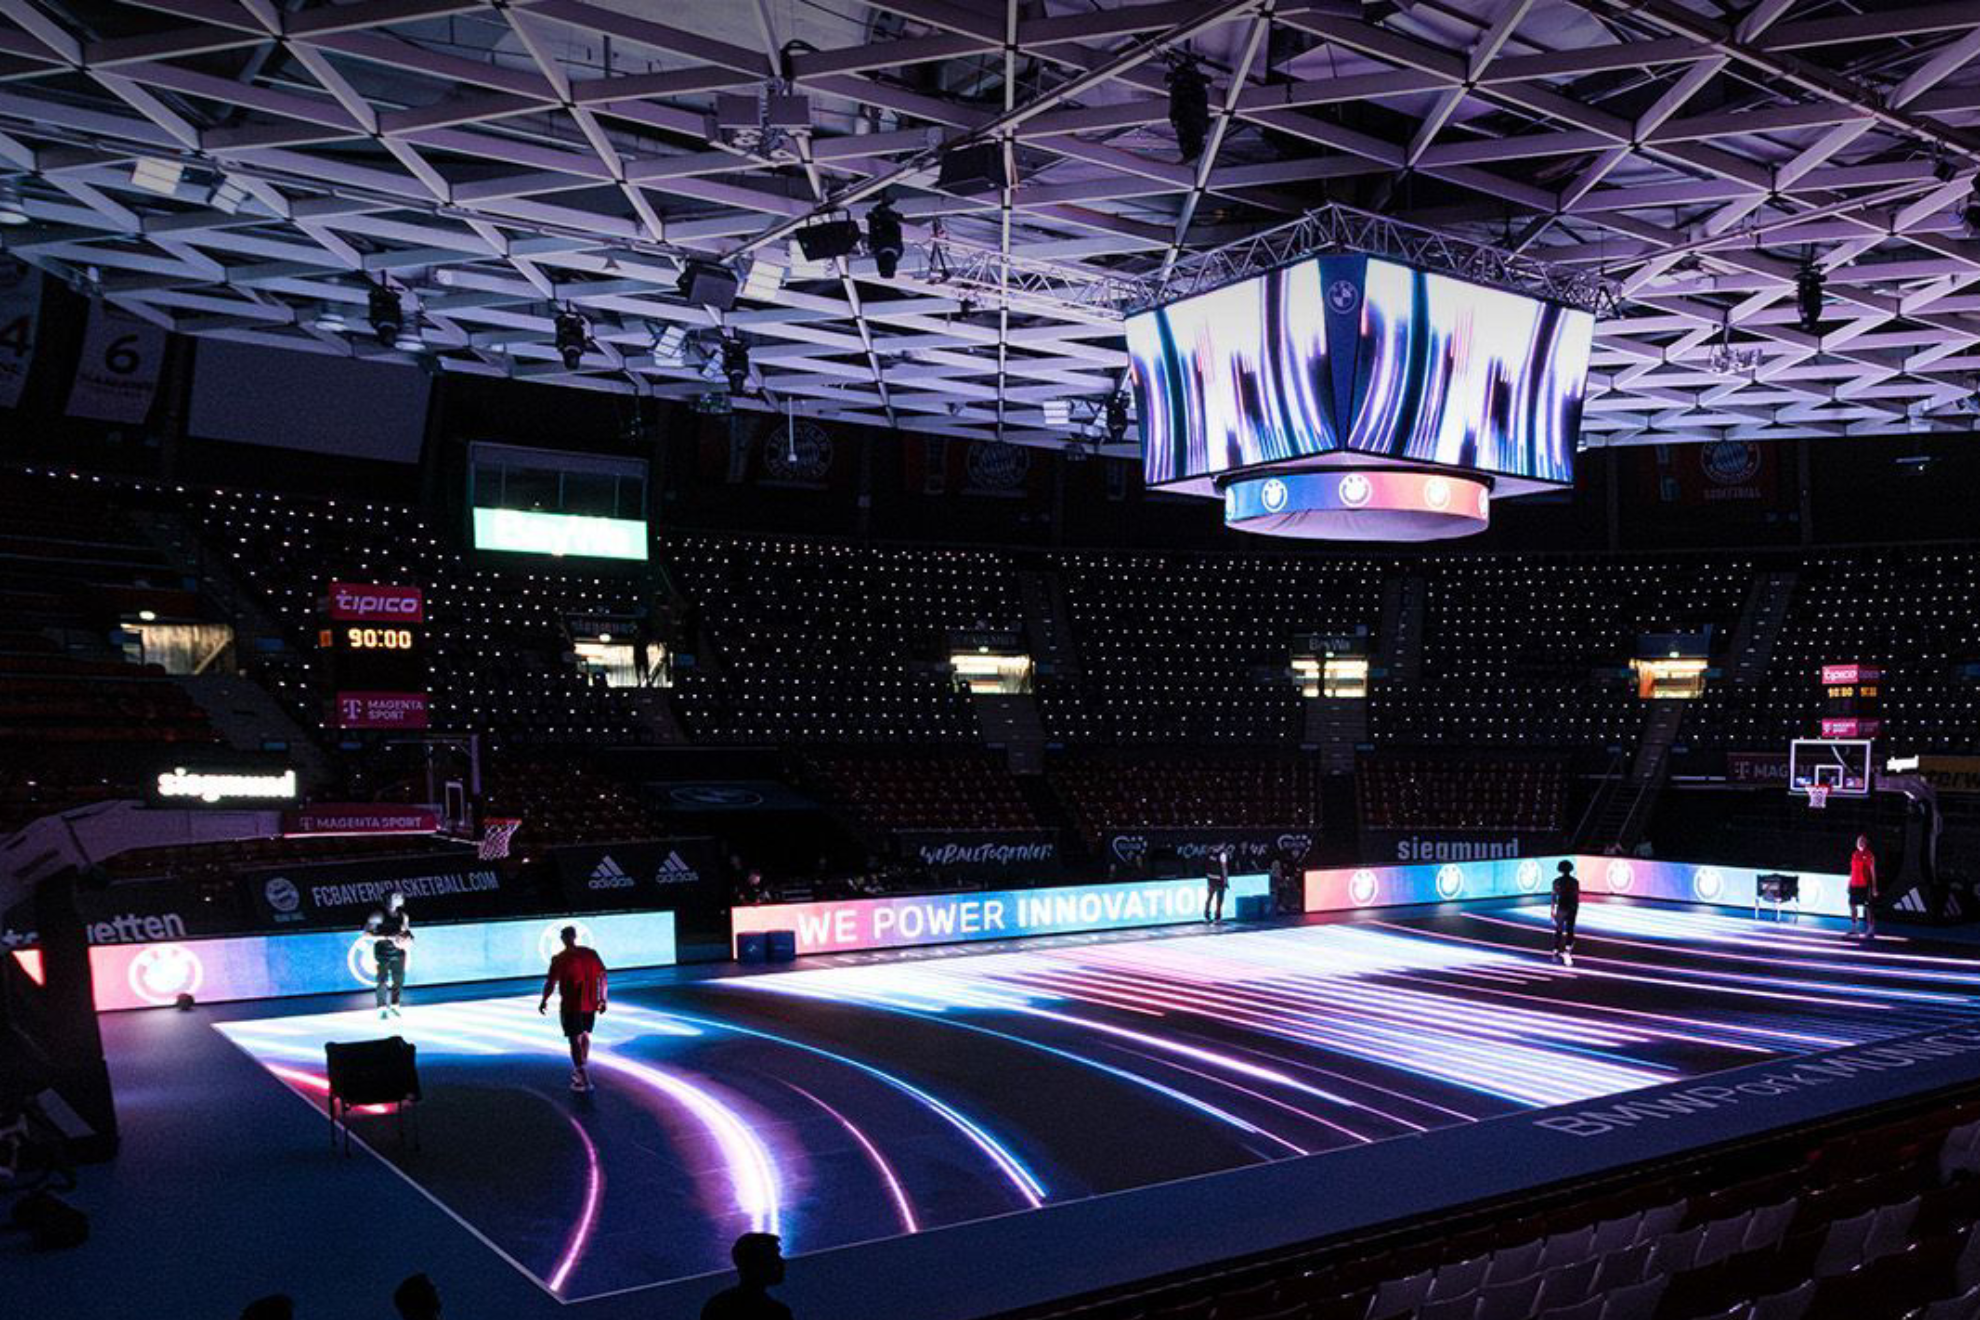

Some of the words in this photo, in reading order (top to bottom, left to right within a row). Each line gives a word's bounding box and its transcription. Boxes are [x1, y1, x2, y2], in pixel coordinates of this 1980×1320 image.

[105, 334, 140, 374] 6
[336, 589, 418, 614] tipico
[348, 628, 412, 649] 90:00
[367, 700, 424, 710] MAGENTA
[368, 711, 404, 720] SPORT
[316, 816, 381, 829] MAGENTA
[381, 816, 422, 828] SPORT
[1397, 835, 1519, 861] siegmund
[799, 909, 858, 946] WE
[872, 899, 1005, 939] POWER
